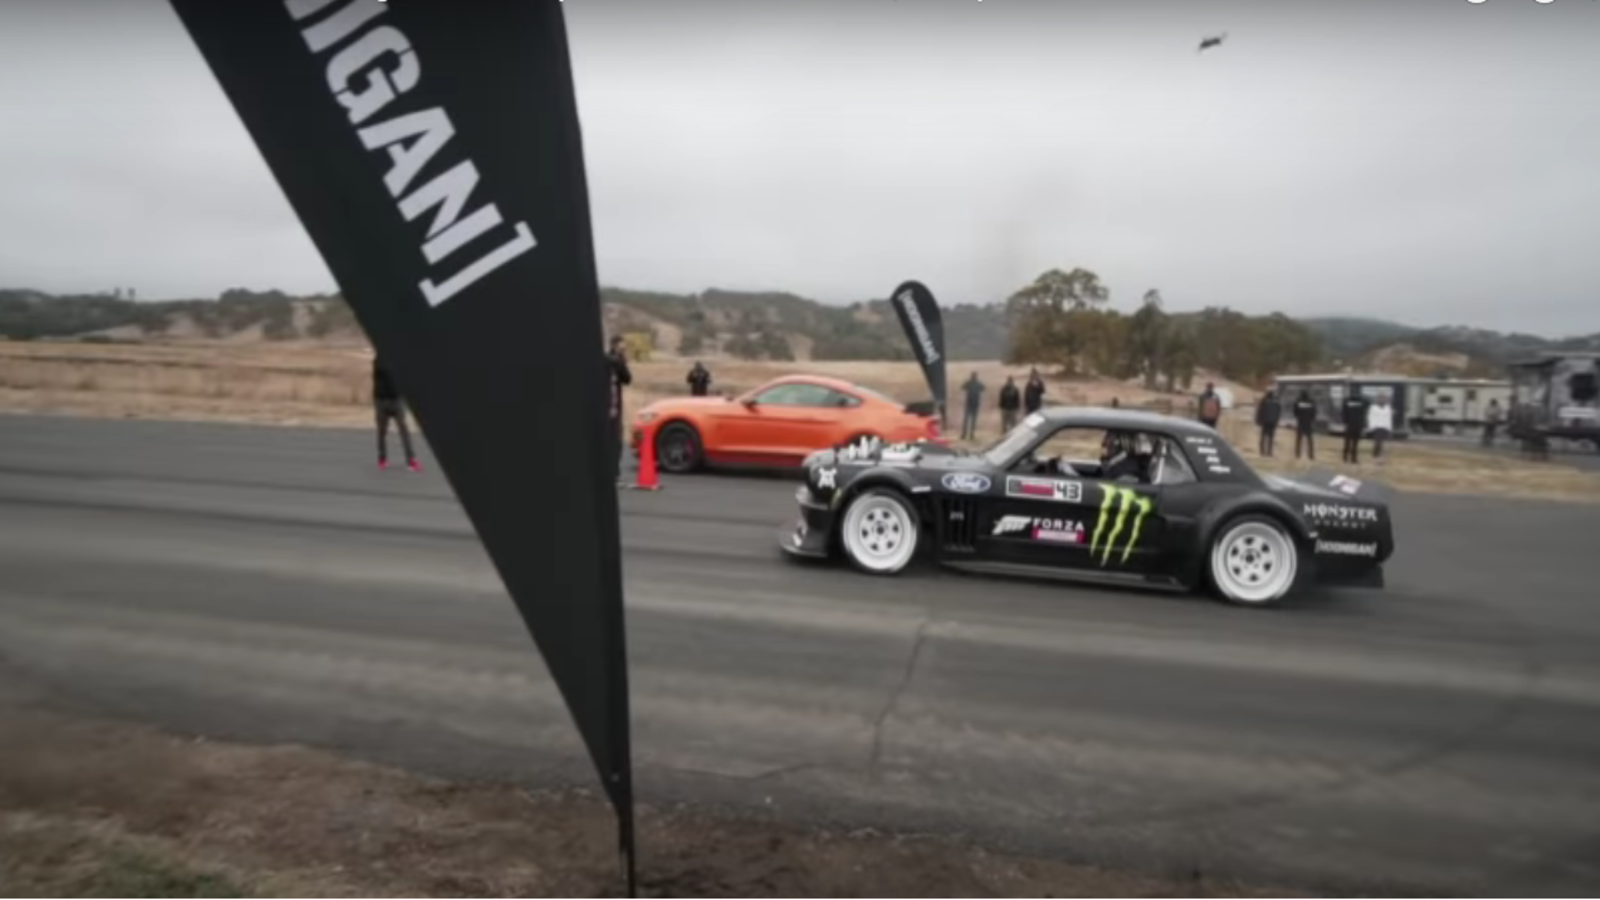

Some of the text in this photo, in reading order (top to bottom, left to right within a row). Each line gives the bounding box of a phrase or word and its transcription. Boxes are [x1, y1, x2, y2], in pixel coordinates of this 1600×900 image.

[284, 0, 538, 308] IGAN]
[945, 473, 990, 492] Ford
[1056, 482, 1080, 499] 43
[1303, 502, 1378, 522] MONSTER
[1032, 517, 1085, 532] FORZA
